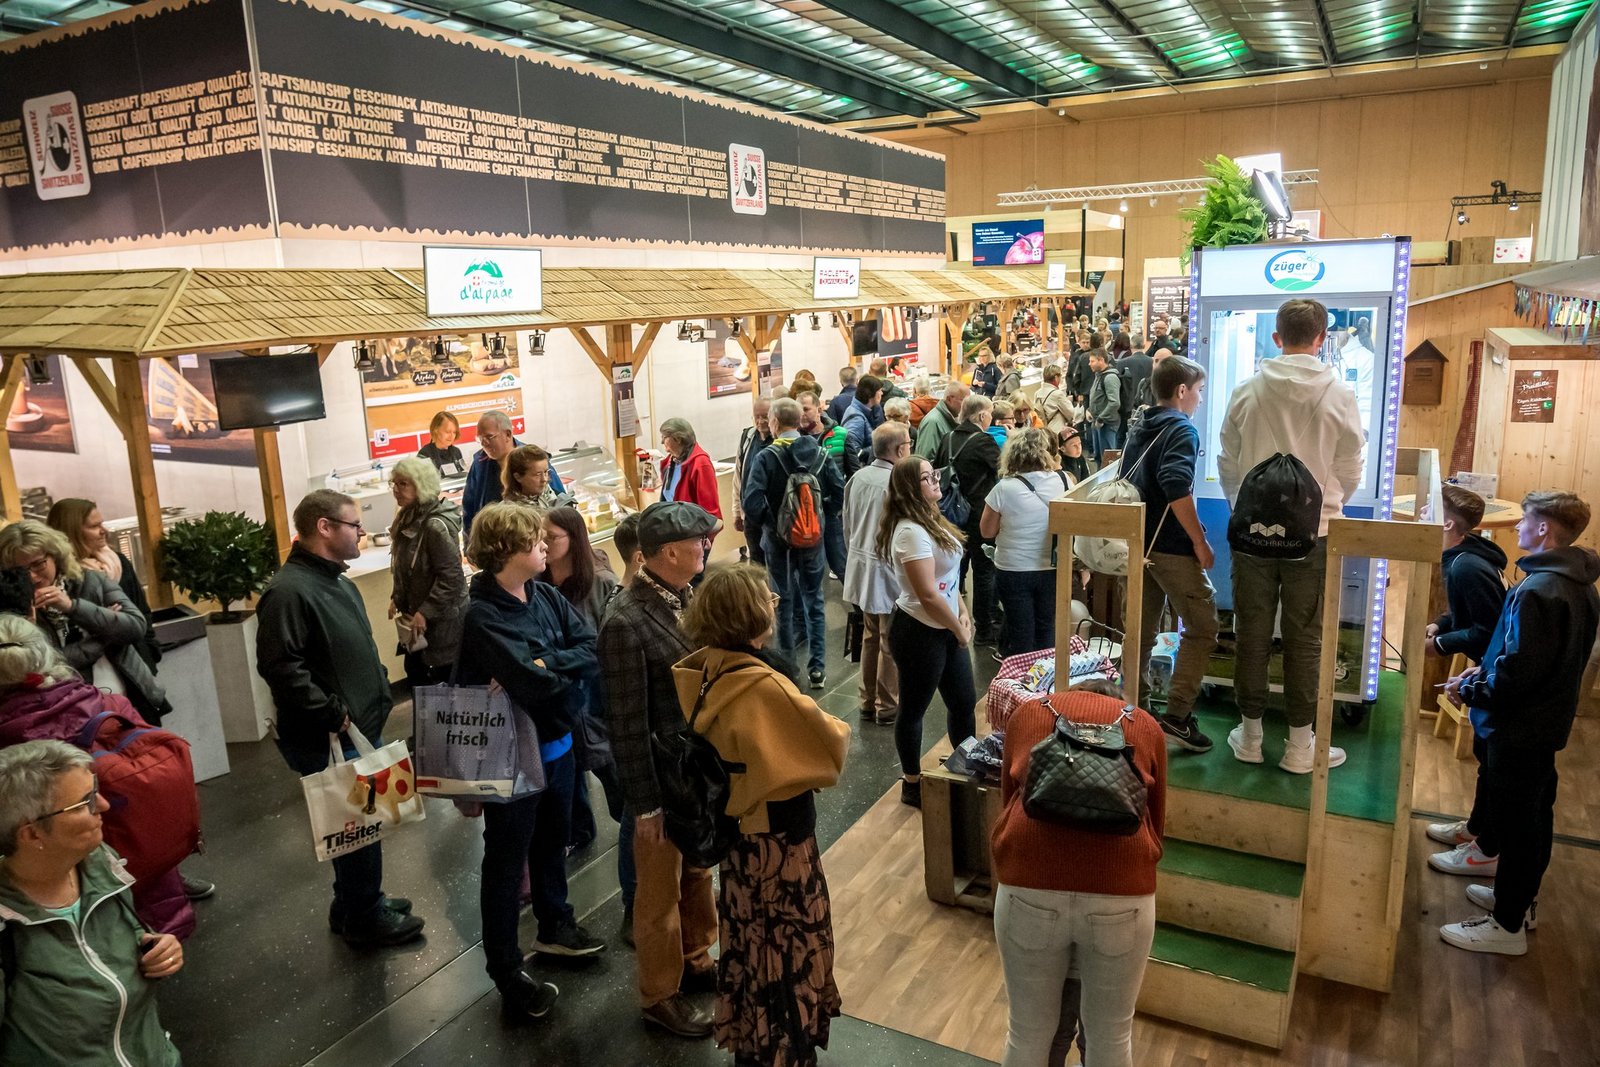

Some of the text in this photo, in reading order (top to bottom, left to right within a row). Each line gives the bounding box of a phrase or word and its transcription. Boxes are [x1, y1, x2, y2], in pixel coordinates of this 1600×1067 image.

[1273, 261, 1307, 273] züger
[436, 710, 505, 727] Natürlich
[446, 730, 489, 746] frisch
[322, 821, 382, 850] Tilsiter
